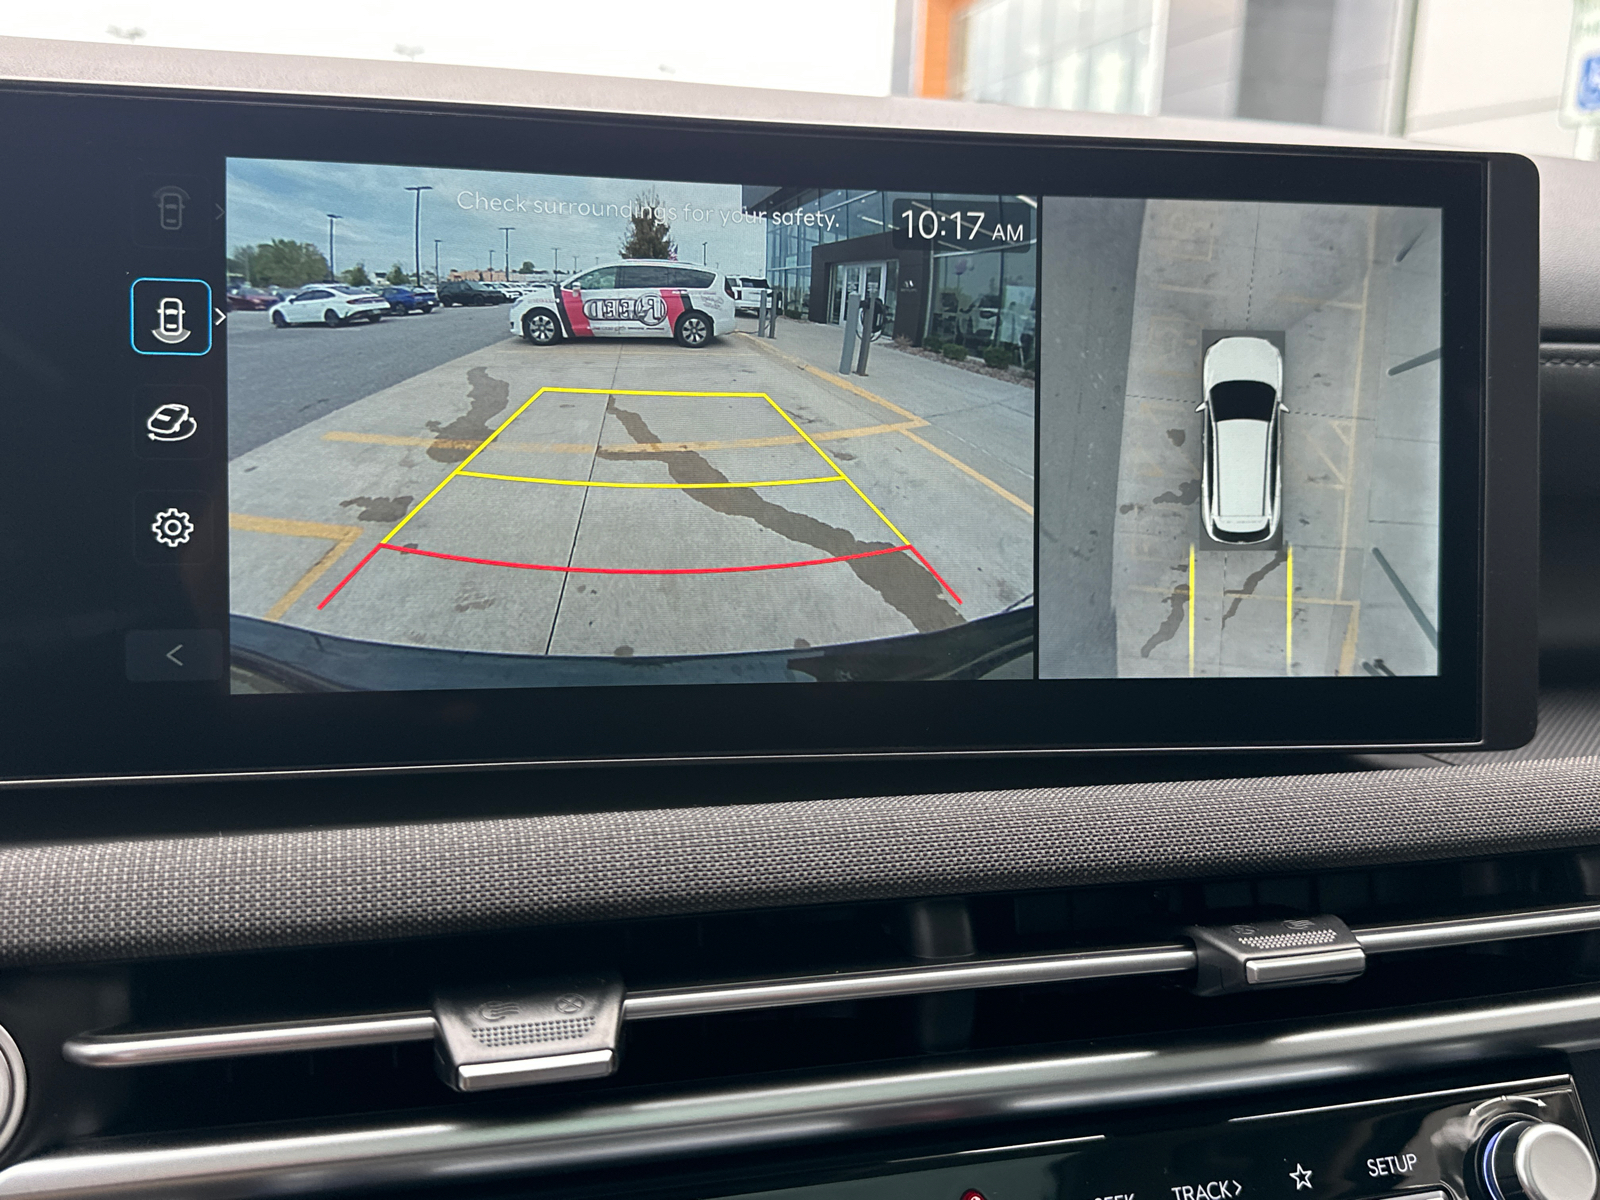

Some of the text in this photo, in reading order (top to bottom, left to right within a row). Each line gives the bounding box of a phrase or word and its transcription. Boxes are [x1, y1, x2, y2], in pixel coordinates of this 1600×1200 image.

[456, 190, 840, 232] Check surroundings for your safety.
[901, 209, 1024, 242] 10:17 AM
[1366, 1153, 1417, 1177] SETUP
